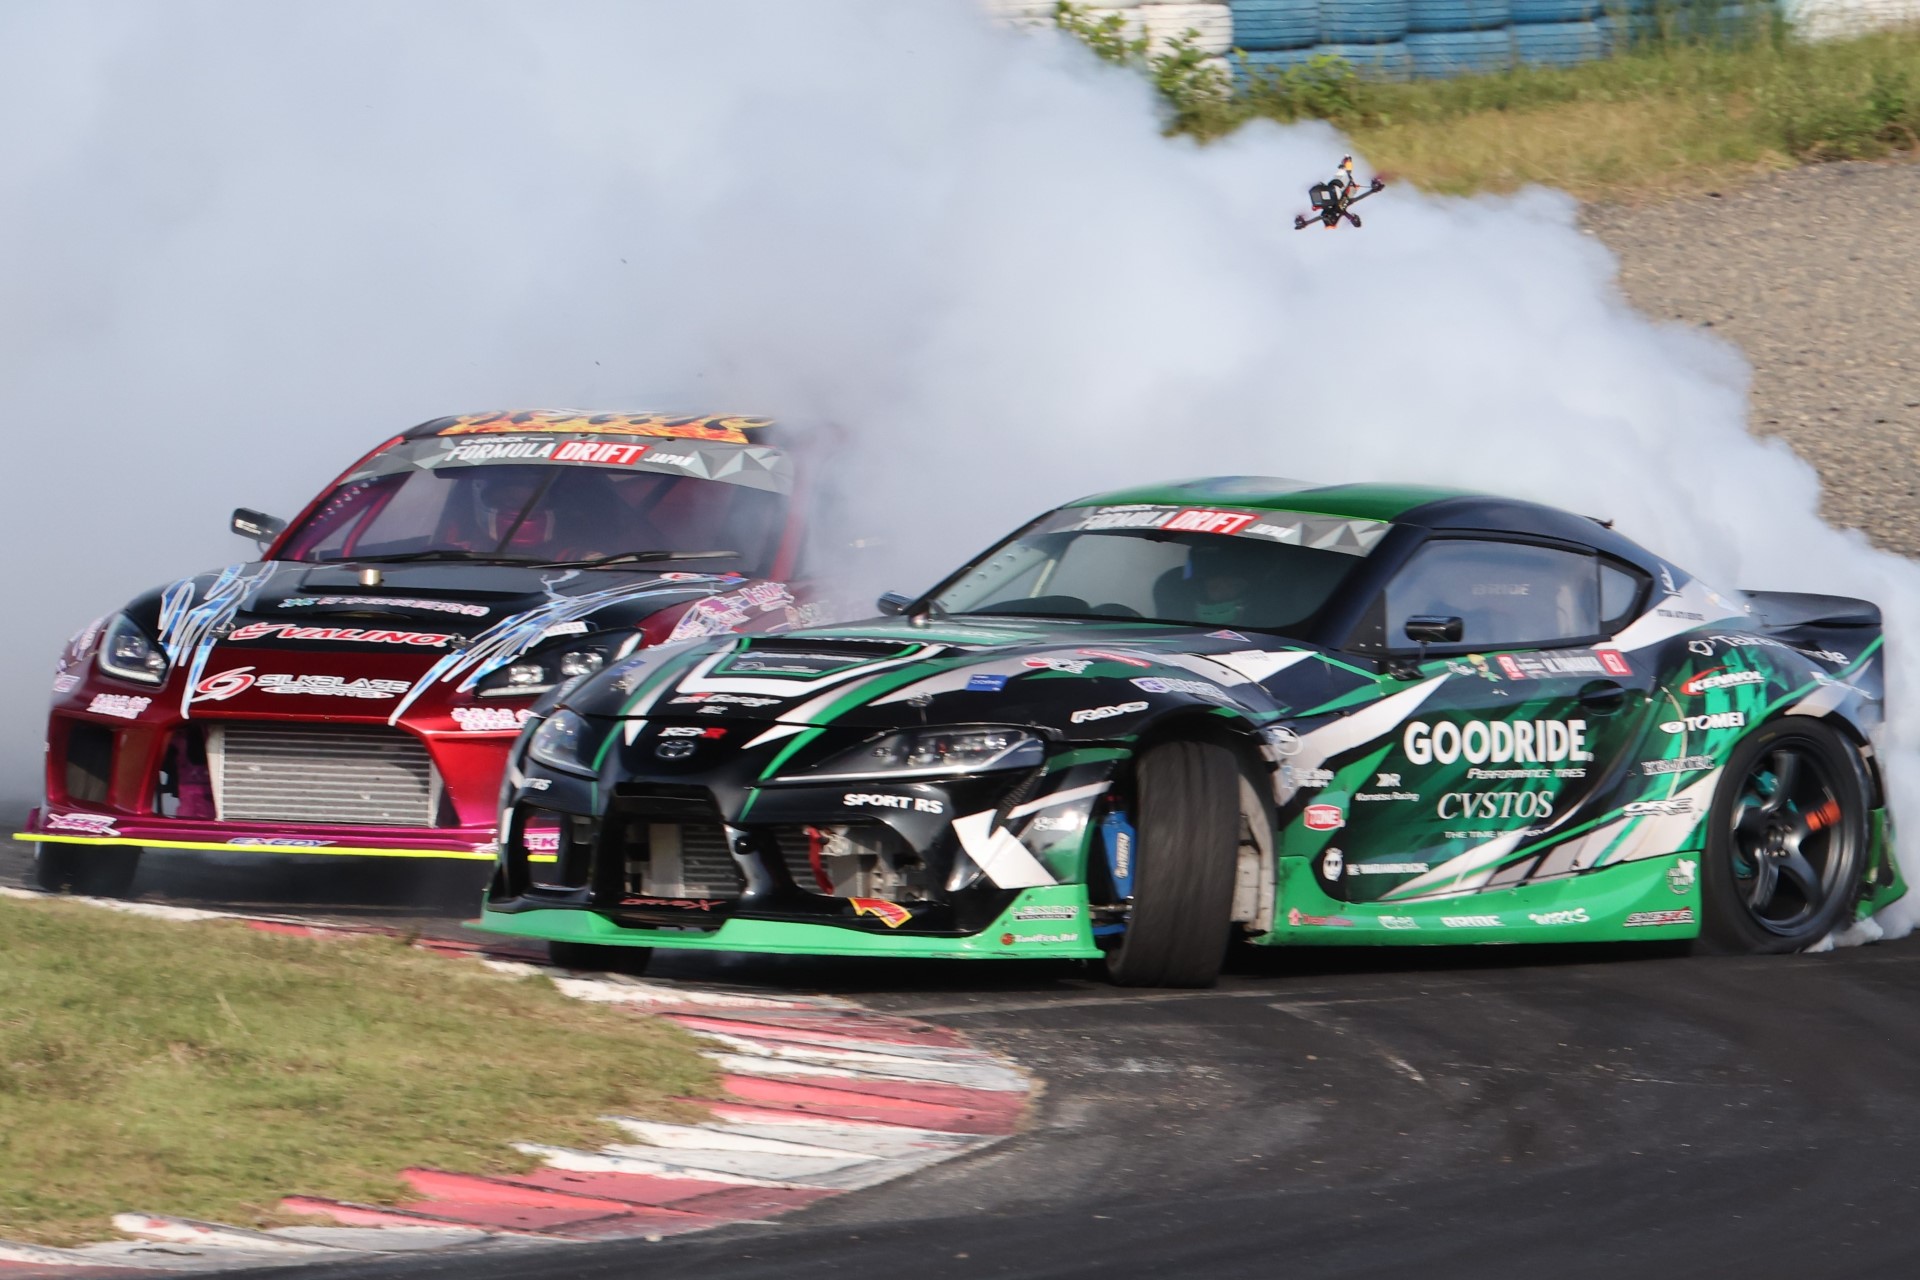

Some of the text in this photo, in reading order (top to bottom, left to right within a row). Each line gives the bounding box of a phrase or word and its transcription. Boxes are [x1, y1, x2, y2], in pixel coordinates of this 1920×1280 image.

[445, 443, 697, 467] FORMULA DRIFT JAPAN
[1078, 511, 1179, 531] FORMULA
[1164, 509, 1255, 535] DRIFT
[276, 627, 454, 647] VALINO
[253, 674, 412, 694] SILKBLAZE
[1687, 671, 1765, 694] KENNOL
[1684, 712, 1745, 731] TOMEI
[1403, 719, 1588, 766] GOODRIDE
[843, 793, 945, 815] SPORT RS
[1437, 790, 1555, 820] CVSTOS
[1444, 831, 1468, 839] THE
